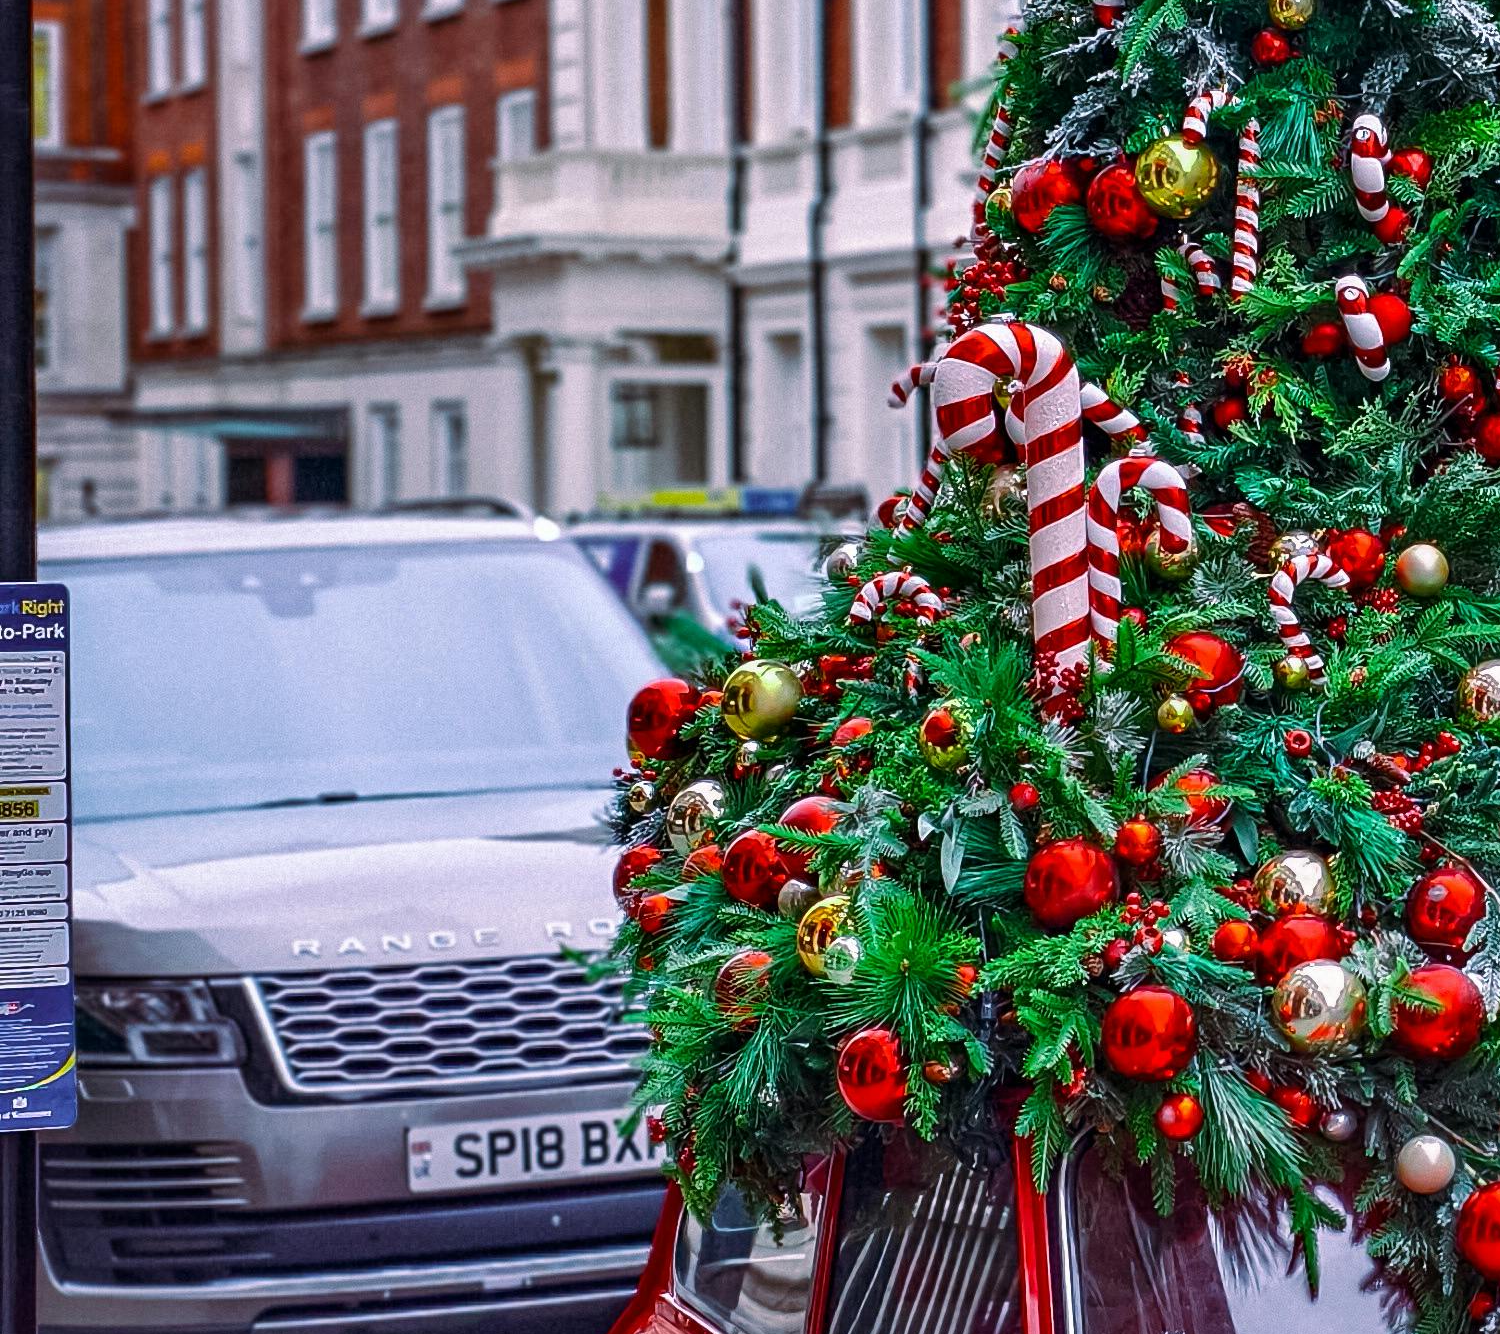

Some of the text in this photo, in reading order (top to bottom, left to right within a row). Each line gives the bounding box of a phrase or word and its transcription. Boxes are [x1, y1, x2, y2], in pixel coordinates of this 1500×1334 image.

[0, 802, 36, 818] 856
[35, 828, 54, 838] pay
[293, 928, 500, 958] RANGE
[454, 1113, 657, 1179] SP18 BX
